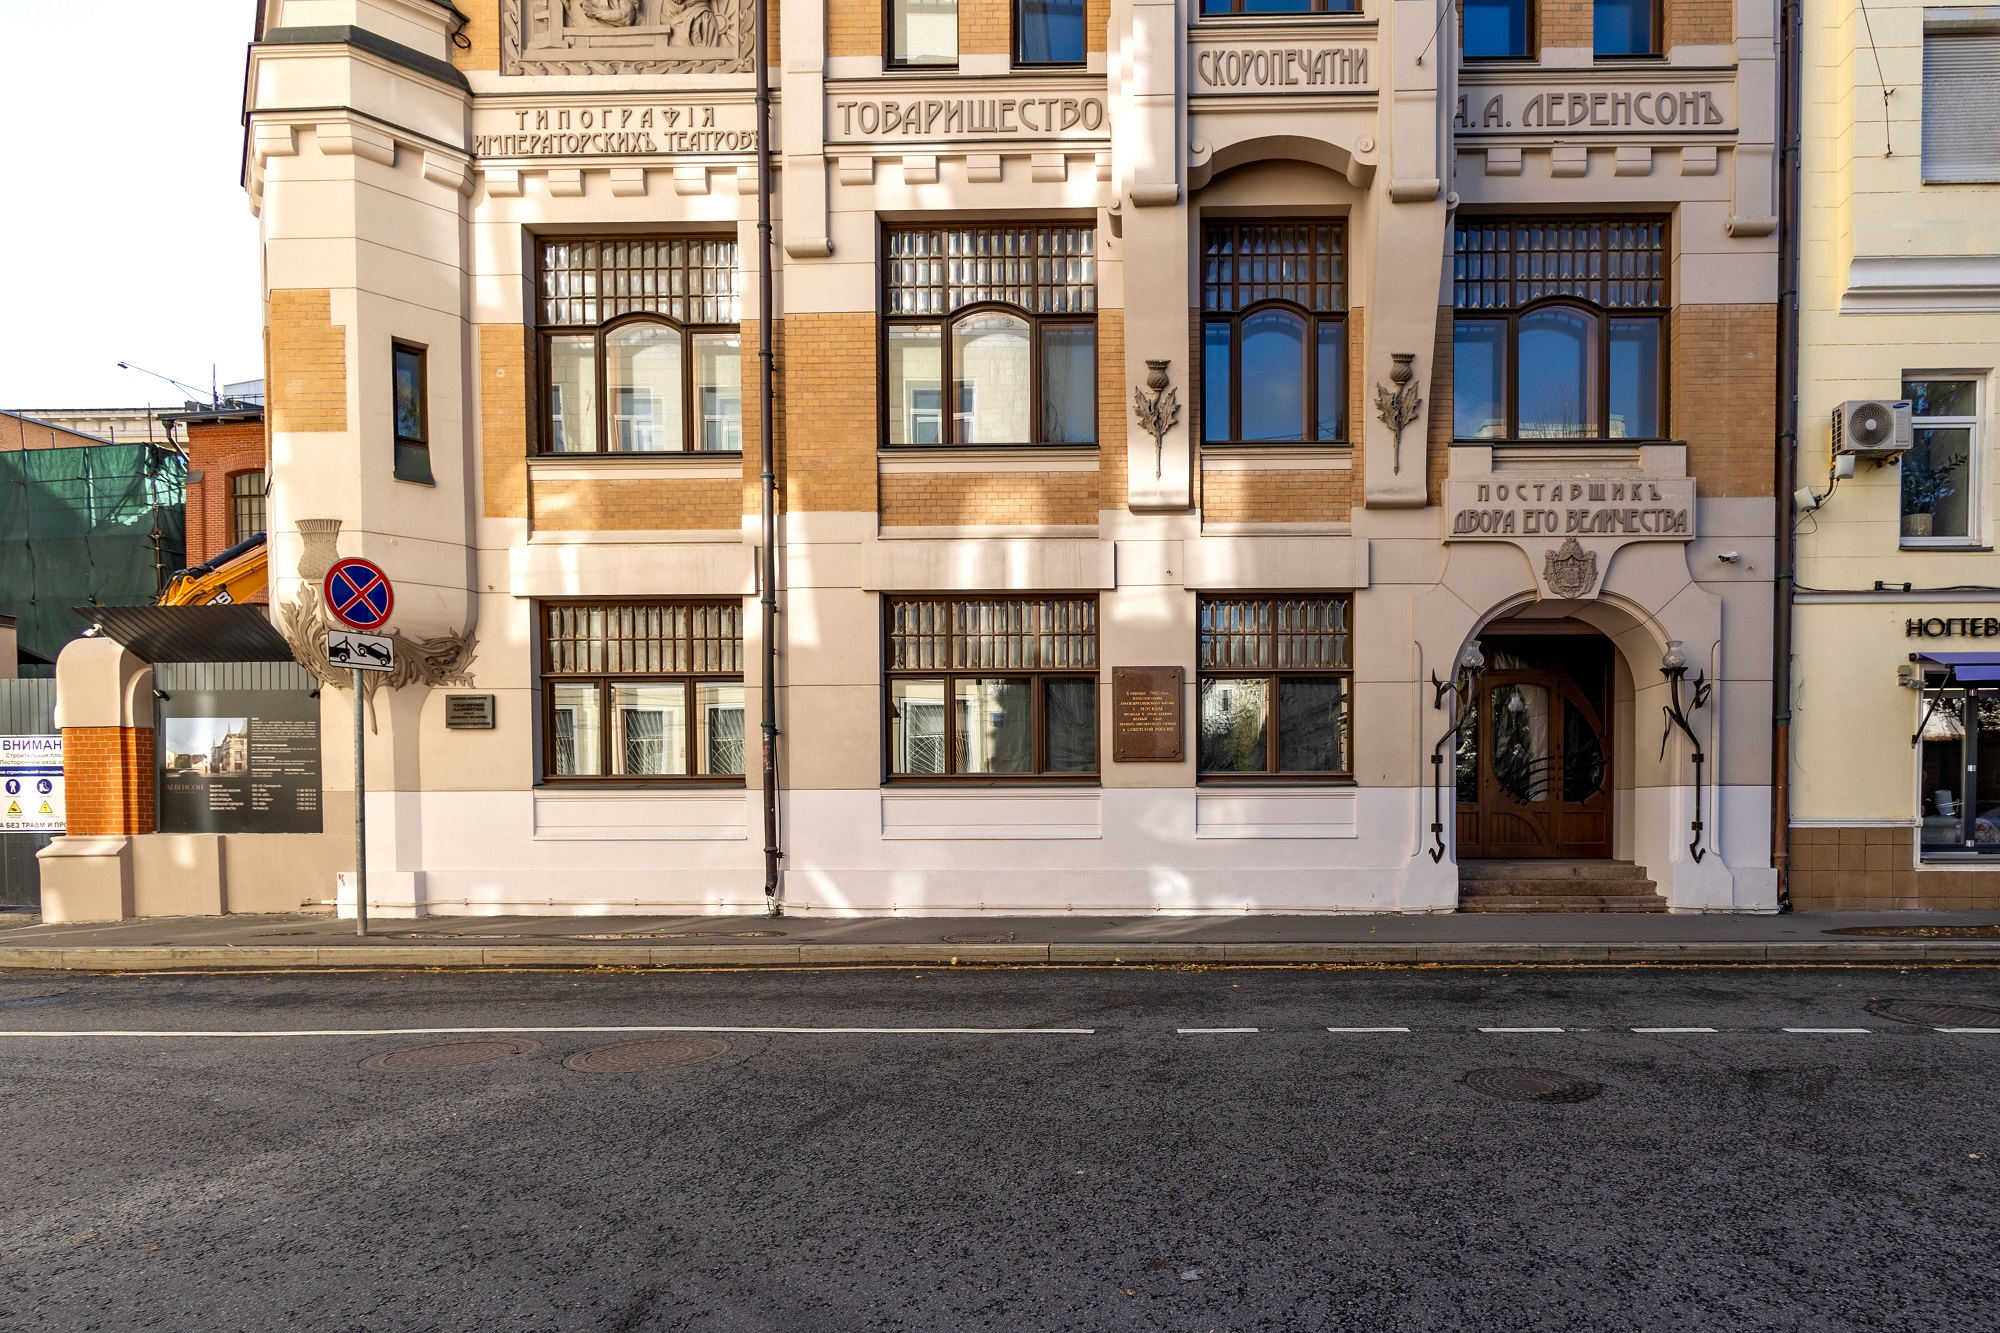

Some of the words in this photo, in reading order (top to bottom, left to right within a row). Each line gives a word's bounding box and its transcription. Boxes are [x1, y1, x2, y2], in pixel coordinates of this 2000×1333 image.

[1198, 48, 1368, 86] СКОРОПЕЧАТНИ
[515, 107, 714, 130] ТИПОГРАФІЯ
[837, 97, 1103, 134] ТОВАРИЩЕСТВО
[1483, 93, 1511, 128] А.
[1522, 91, 1723, 127] ЛЕВЕНСОНЪ
[473, 131, 657, 155] ИМПЕРАТОРСКИХЪ
[1477, 483, 1662, 501] ПОСТАВЩИКЪ
[1453, 508, 1515, 534] ДВОРА
[1522, 508, 1559, 534] ЕГО
[1566, 508, 1688, 534] ВЕЛИЧЕСТВА
[1905, 617, 2000, 638] НОГТЕВ
[2, 739, 62, 751] ВНИМАН
